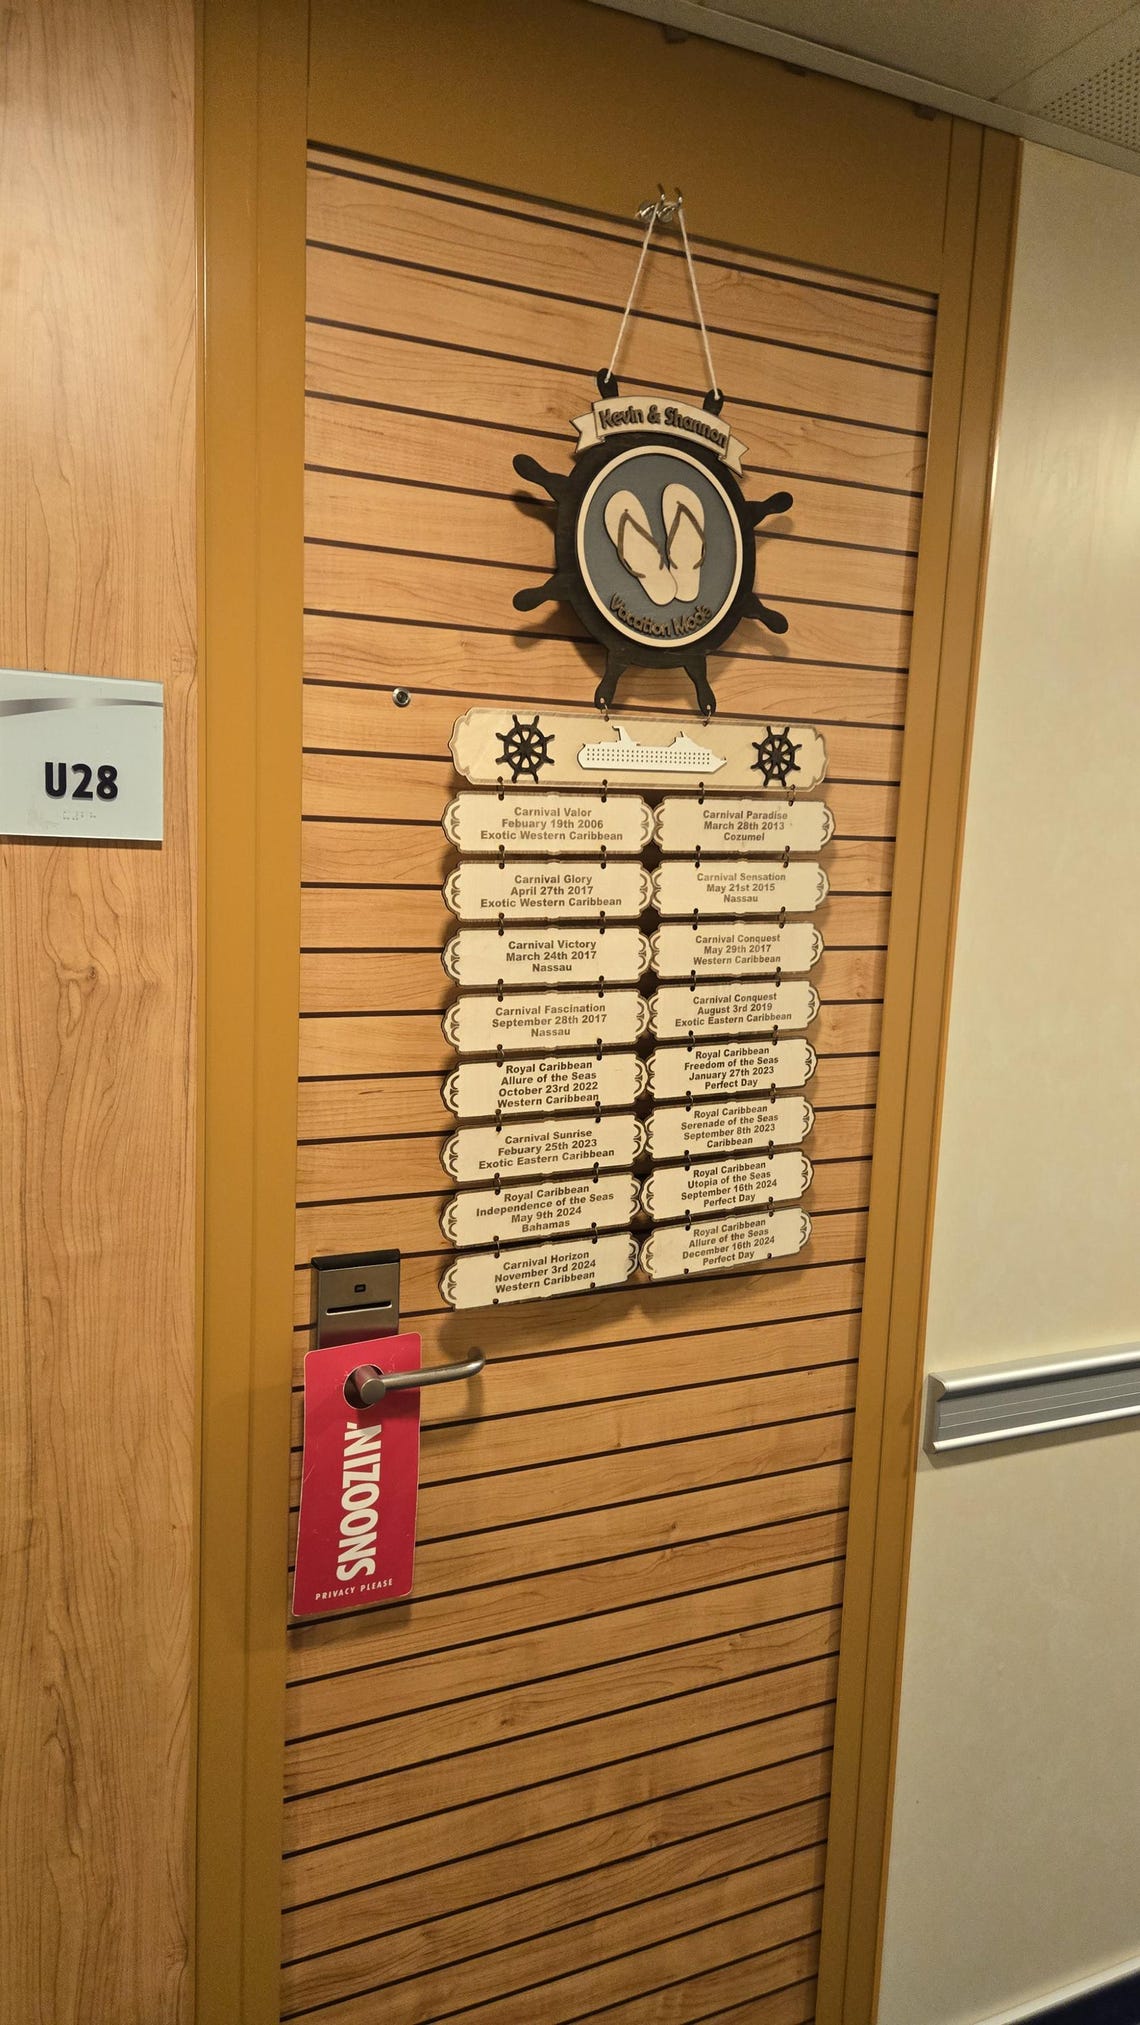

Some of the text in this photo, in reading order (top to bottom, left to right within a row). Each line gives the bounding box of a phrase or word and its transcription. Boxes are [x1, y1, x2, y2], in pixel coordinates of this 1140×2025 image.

[600, 405, 728, 448] Kevin & Shannon
[610, 592, 713, 637] Vacation Mode
[45, 762, 118, 800] U28
[514, 807, 592, 817] Carnival Valor
[703, 810, 788, 820] Carnival Paradise
[502, 819, 603, 831] Febuary 19th 2006
[704, 821, 785, 830] March 28th 2013
[480, 831, 623, 841] Exotic Western Caribbean
[724, 832, 764, 841] Cozumel
[514, 874, 592, 886] Carnival Glory
[697, 873, 786, 881] Carnival Sensation
[511, 886, 593, 897] April 27th 2017
[707, 883, 775, 894] May 21st 2015
[480, 897, 622, 908] Exotic Western Caribbean
[724, 894, 758, 903] Nassau
[508, 940, 596, 950] Carnival Victory
[695, 934, 781, 944] Carnival Conquest
[506, 951, 597, 961] March 24th 2017
[704, 944, 771, 956] May 29th 2017
[693, 955, 781, 965] Western Caribbean
[532, 963, 572, 972] Nassau
[693, 992, 776, 1005] Carnival Conquest
[495, 1004, 606, 1016] Carnival Fascination
[698, 1003, 772, 1016] August 3rd 2019
[492, 1014, 607, 1028] September 28th 2017
[675, 1012, 792, 1027] Exotic Eastern Caribbean
[531, 1028, 570, 1037] Nassau
[695, 1046, 769, 1060] Royal Caribbean
[506, 1061, 592, 1075] Royal Caribbean
[684, 1056, 779, 1071] Freedom of the Seas
[501, 1071, 597, 1086] Allure of the Seas
[689, 1066, 774, 1081] January 27th 2023
[499, 1082, 598, 1097] October 23rd 2022
[705, 1078, 758, 1090] Perfect Day
[497, 1093, 599, 1108] Western Caribbean
[694, 1105, 768, 1119] Royal Caribbean
[681, 1120, 725, 1131] Serenade
[757, 1114, 778, 1123] Seas
[505, 1129, 592, 1145] Carnival Sunrise
[684, 1123, 775, 1141] September 8th 2023
[498, 1139, 597, 1156] Febuary 25th 2023
[707, 1137, 753, 1149] Caribbean
[479, 1149, 614, 1170] Exotic Eastern Caribbean
[693, 1161, 766, 1179] Royal Caribbean
[688, 1171, 771, 1190] Utopia of the Seas
[504, 1185, 589, 1203] Royal Caribbean
[681, 1179, 777, 1201] September 16th 2024
[476, 1192, 614, 1217] Independence of the Seas
[703, 1194, 756, 1208] Perfect Day
[511, 1207, 581, 1225] May 9th 2024
[522, 1220, 570, 1233] Bahamas
[694, 1219, 766, 1238] Royal Caribbean
[689, 1236, 716, 1248] Allure
[730, 1232, 745, 1241] the
[747, 1228, 768, 1238] Seas
[682, 1236, 775, 1260] December 16th 2024
[503, 1251, 589, 1271] Carnival Horizon
[703, 1250, 754, 1266] Perfect Day
[494, 1260, 596, 1283] November 3rd 2024
[496, 1271, 594, 1294] Western Caribbean
[336, 1421, 382, 1582] SNOOZIN'
[316, 1578, 393, 1600] PRIVACY PLEASE
